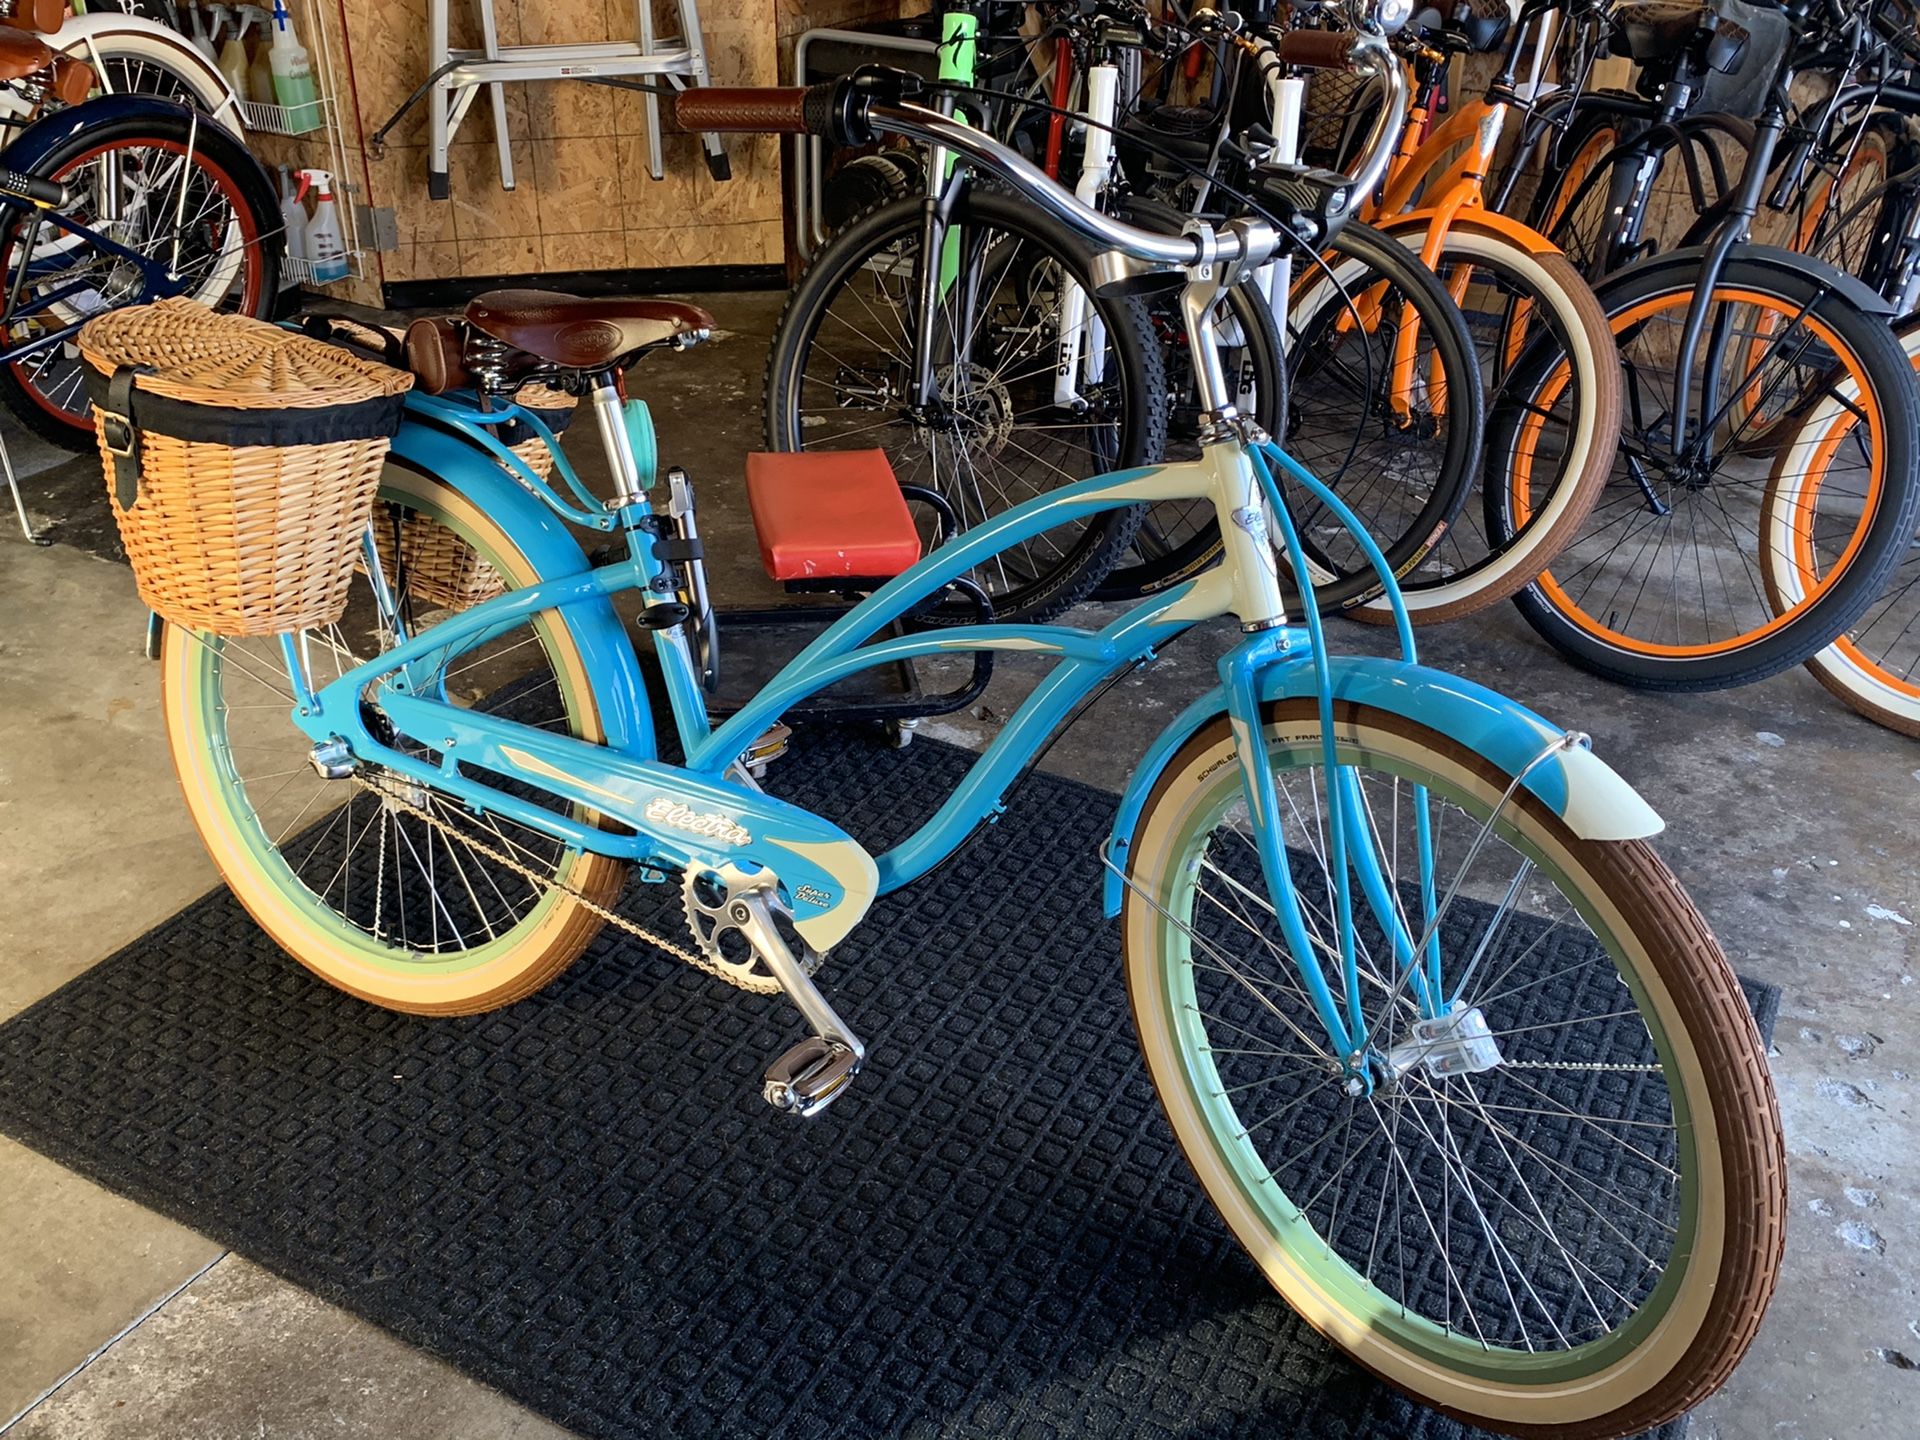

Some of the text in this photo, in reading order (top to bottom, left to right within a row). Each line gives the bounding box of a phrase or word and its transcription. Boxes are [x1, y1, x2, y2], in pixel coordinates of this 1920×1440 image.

[1271, 736, 1291, 745] FAT
[1294, 734, 1323, 742] FRAN
[645, 798, 753, 847] Electra
[794, 891, 830, 908] Deluxe
[796, 884, 831, 899] Super
